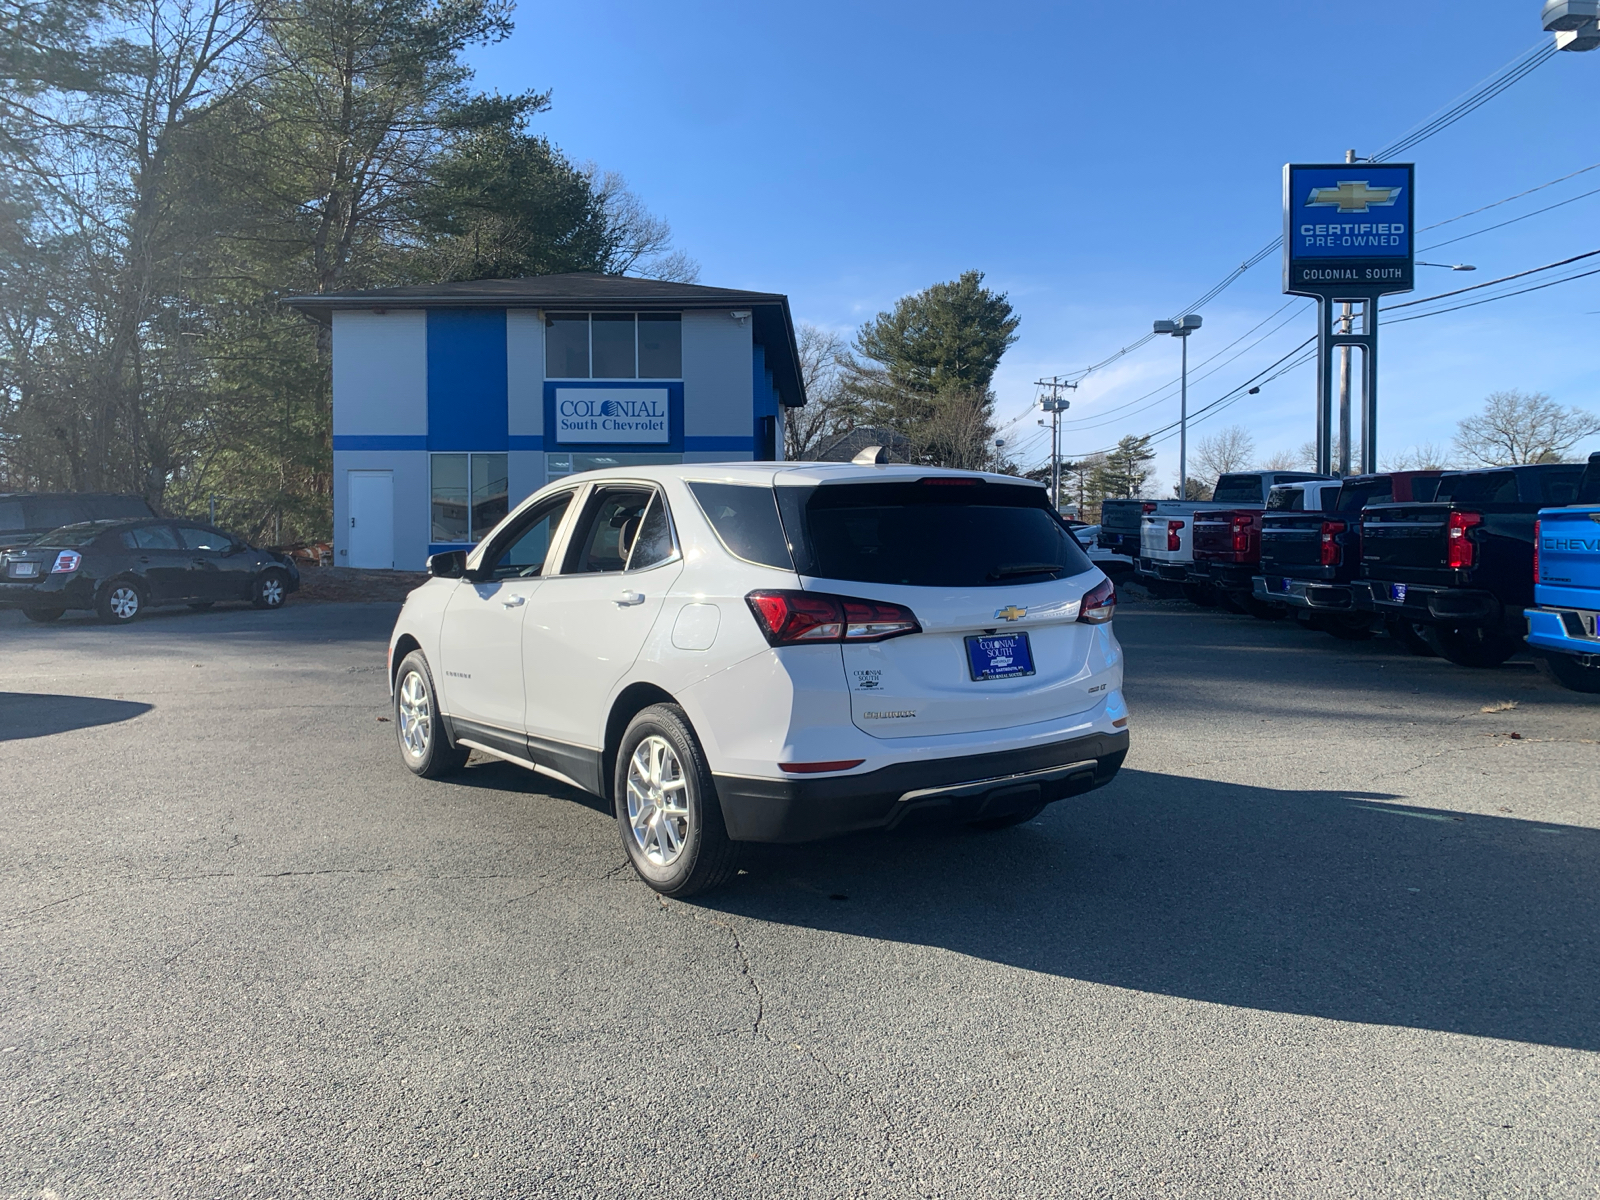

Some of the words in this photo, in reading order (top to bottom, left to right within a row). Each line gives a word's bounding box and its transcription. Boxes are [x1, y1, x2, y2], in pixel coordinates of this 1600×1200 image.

[1300, 223, 1404, 235] CERTIFIED
[1305, 235, 1400, 247] PRE-OWNED
[1303, 269, 1359, 279] COLONIAL
[1365, 268, 1402, 279] SOUTH
[560, 399, 665, 418] COLONIAL
[561, 418, 598, 431] South
[602, 418, 664, 431] Chevrolet
[1543, 538, 1600, 552] CHEV
[980, 640, 1016, 650] COLONIAL
[986, 648, 1012, 658] SOUTH
